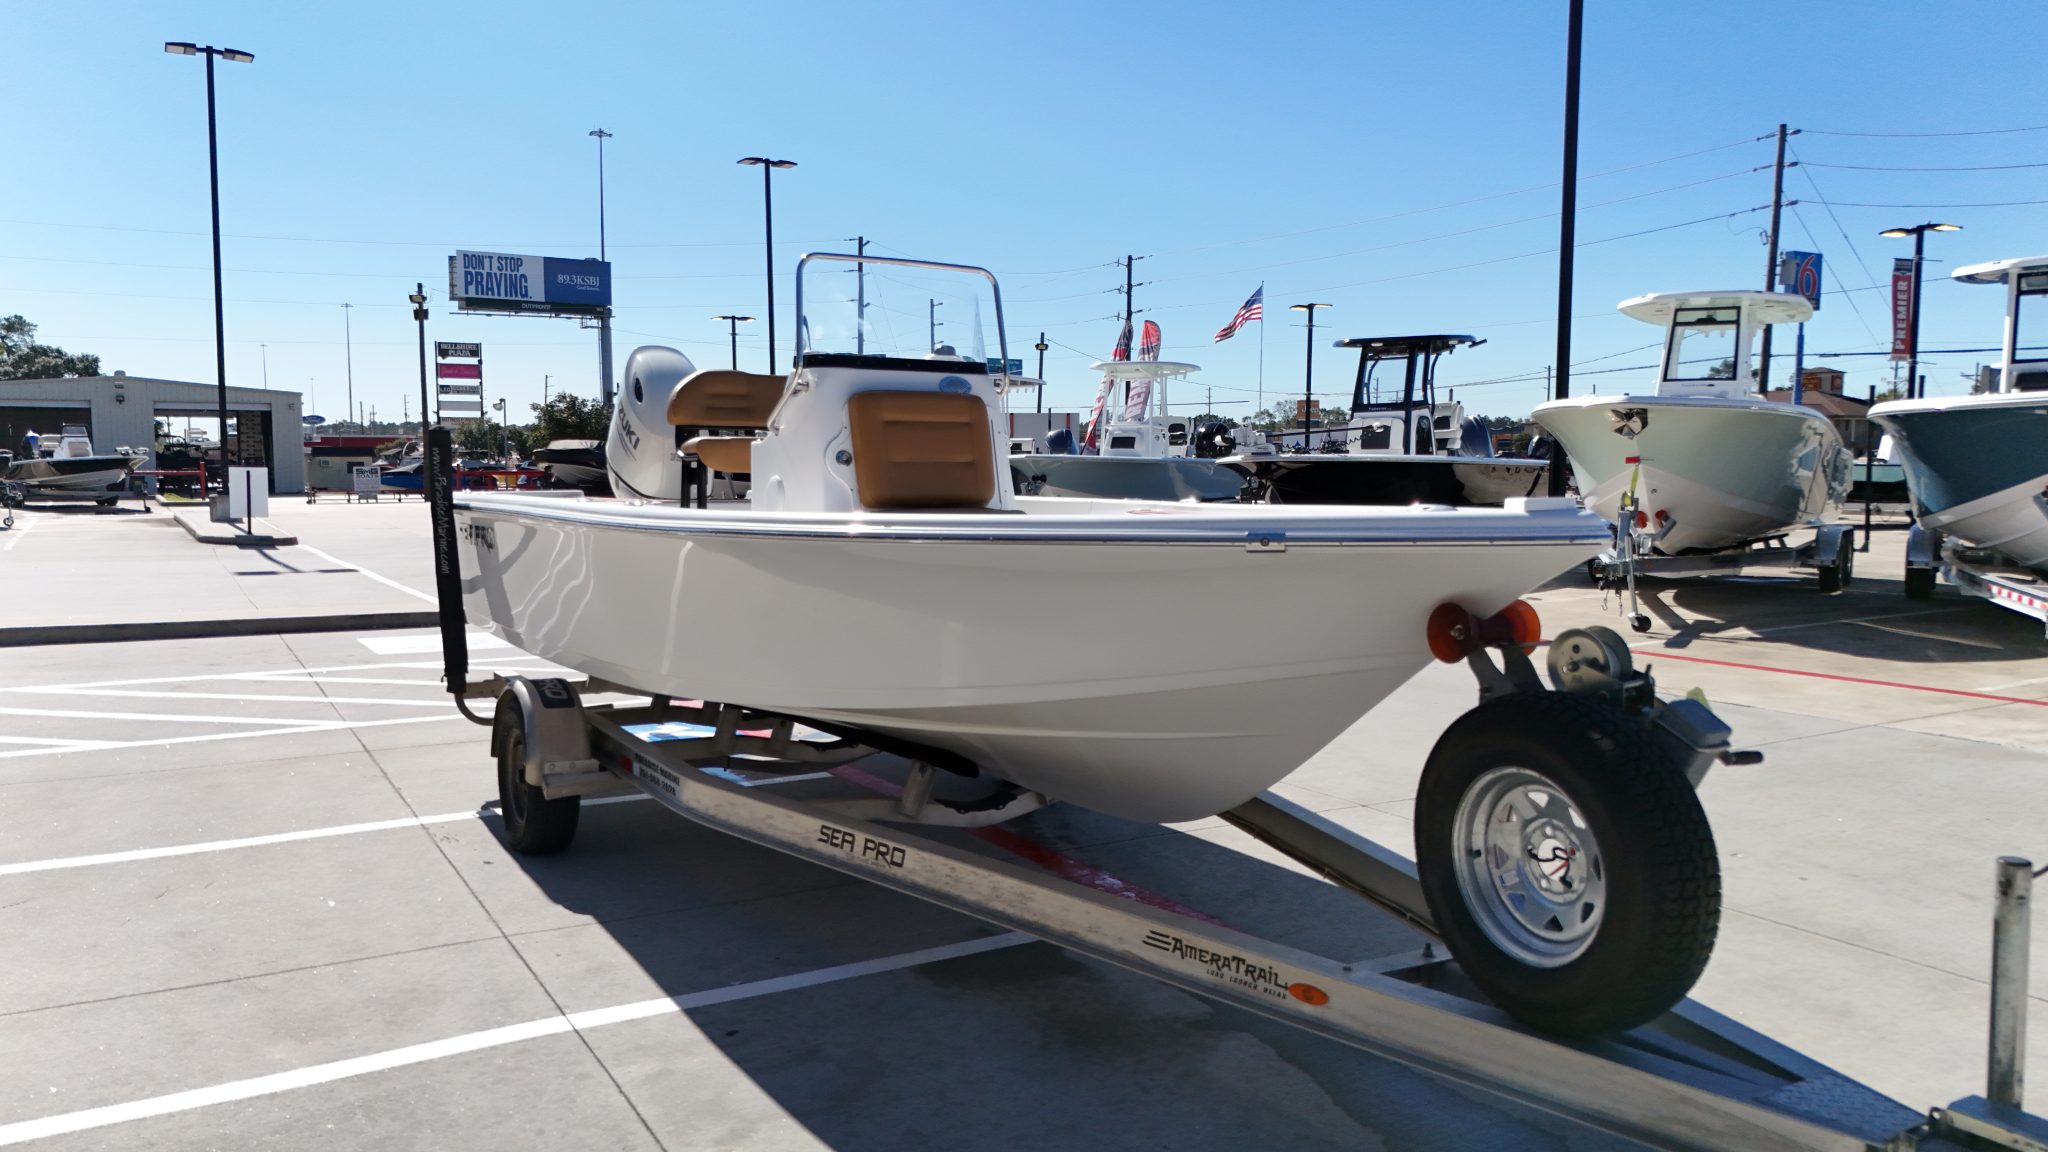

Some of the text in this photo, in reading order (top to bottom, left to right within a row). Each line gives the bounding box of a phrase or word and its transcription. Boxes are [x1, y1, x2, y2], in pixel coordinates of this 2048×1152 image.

[463, 253, 523, 273] DON'T STOP
[464, 270, 533, 299] PRAYING.
[1797, 255, 1819, 299] 6
[1894, 280, 1909, 350] PREMIER
[817, 824, 906, 868] SEA PRO
